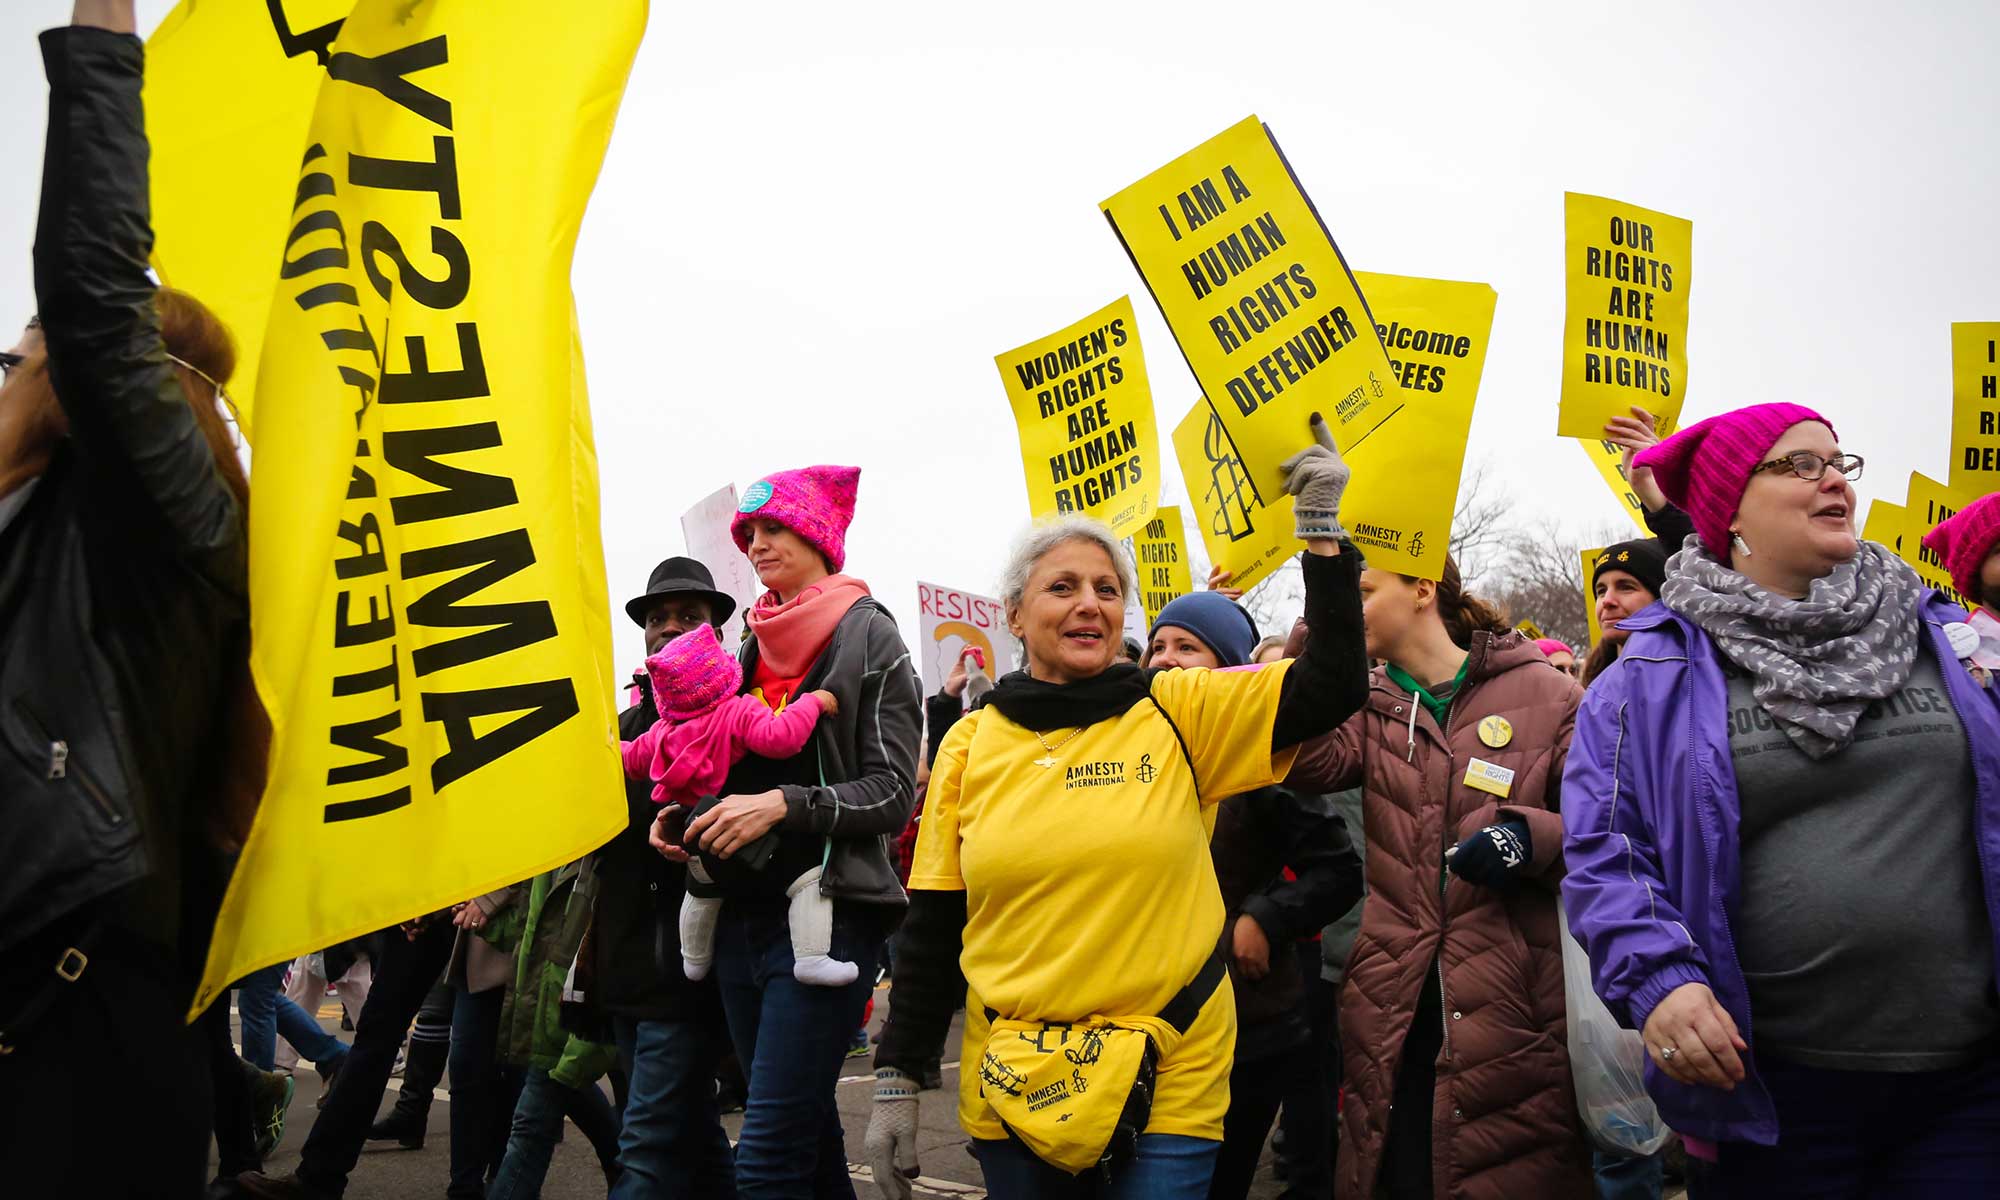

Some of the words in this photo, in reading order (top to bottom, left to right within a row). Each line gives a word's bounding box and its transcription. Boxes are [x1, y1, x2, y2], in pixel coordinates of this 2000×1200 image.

[1158, 204, 1182, 242] I
[1177, 178, 1227, 232] AM
[1221, 165, 1251, 204] A
[1610, 216, 1654, 253] OUR
[1181, 211, 1287, 300] HUMAN
[1586, 246, 1673, 293] RIGHTS
[1209, 263, 1317, 355] RIGHTS
[1608, 286, 1654, 322] ARE
[1015, 318, 1128, 391] WOMEN'S
[1586, 318, 1668, 362] HUMAN
[1988, 340, 1995, 363] I
[1225, 306, 1358, 418] DEFENDER
[1585, 353, 1671, 397] RIGHTS
[1037, 356, 1124, 420] RIGHTS
[1335, 385, 1366, 416] AMNESTY
[1067, 398, 1111, 443] ARE
[1049, 420, 1137, 485] HUMAN
[1055, 455, 1142, 516] RIGHTS
[1146, 519, 1167, 539] OUR
[1927, 500, 1934, 525] I
[1353, 535, 1399, 552] INTERNATIONAL
[1354, 522, 1402, 543] AMNESTY
[1141, 542, 1178, 563] RIGHTS
[1152, 567, 1170, 588] ARE
[918, 584, 1004, 631] RESIST
[1066, 762, 1124, 780] AMNESTY
[1066, 776, 1125, 790] INTERNATIONAL
[1026, 1079, 1067, 1105] AMNESTY
[1028, 1091, 1071, 1112] INTERNATIONAL
